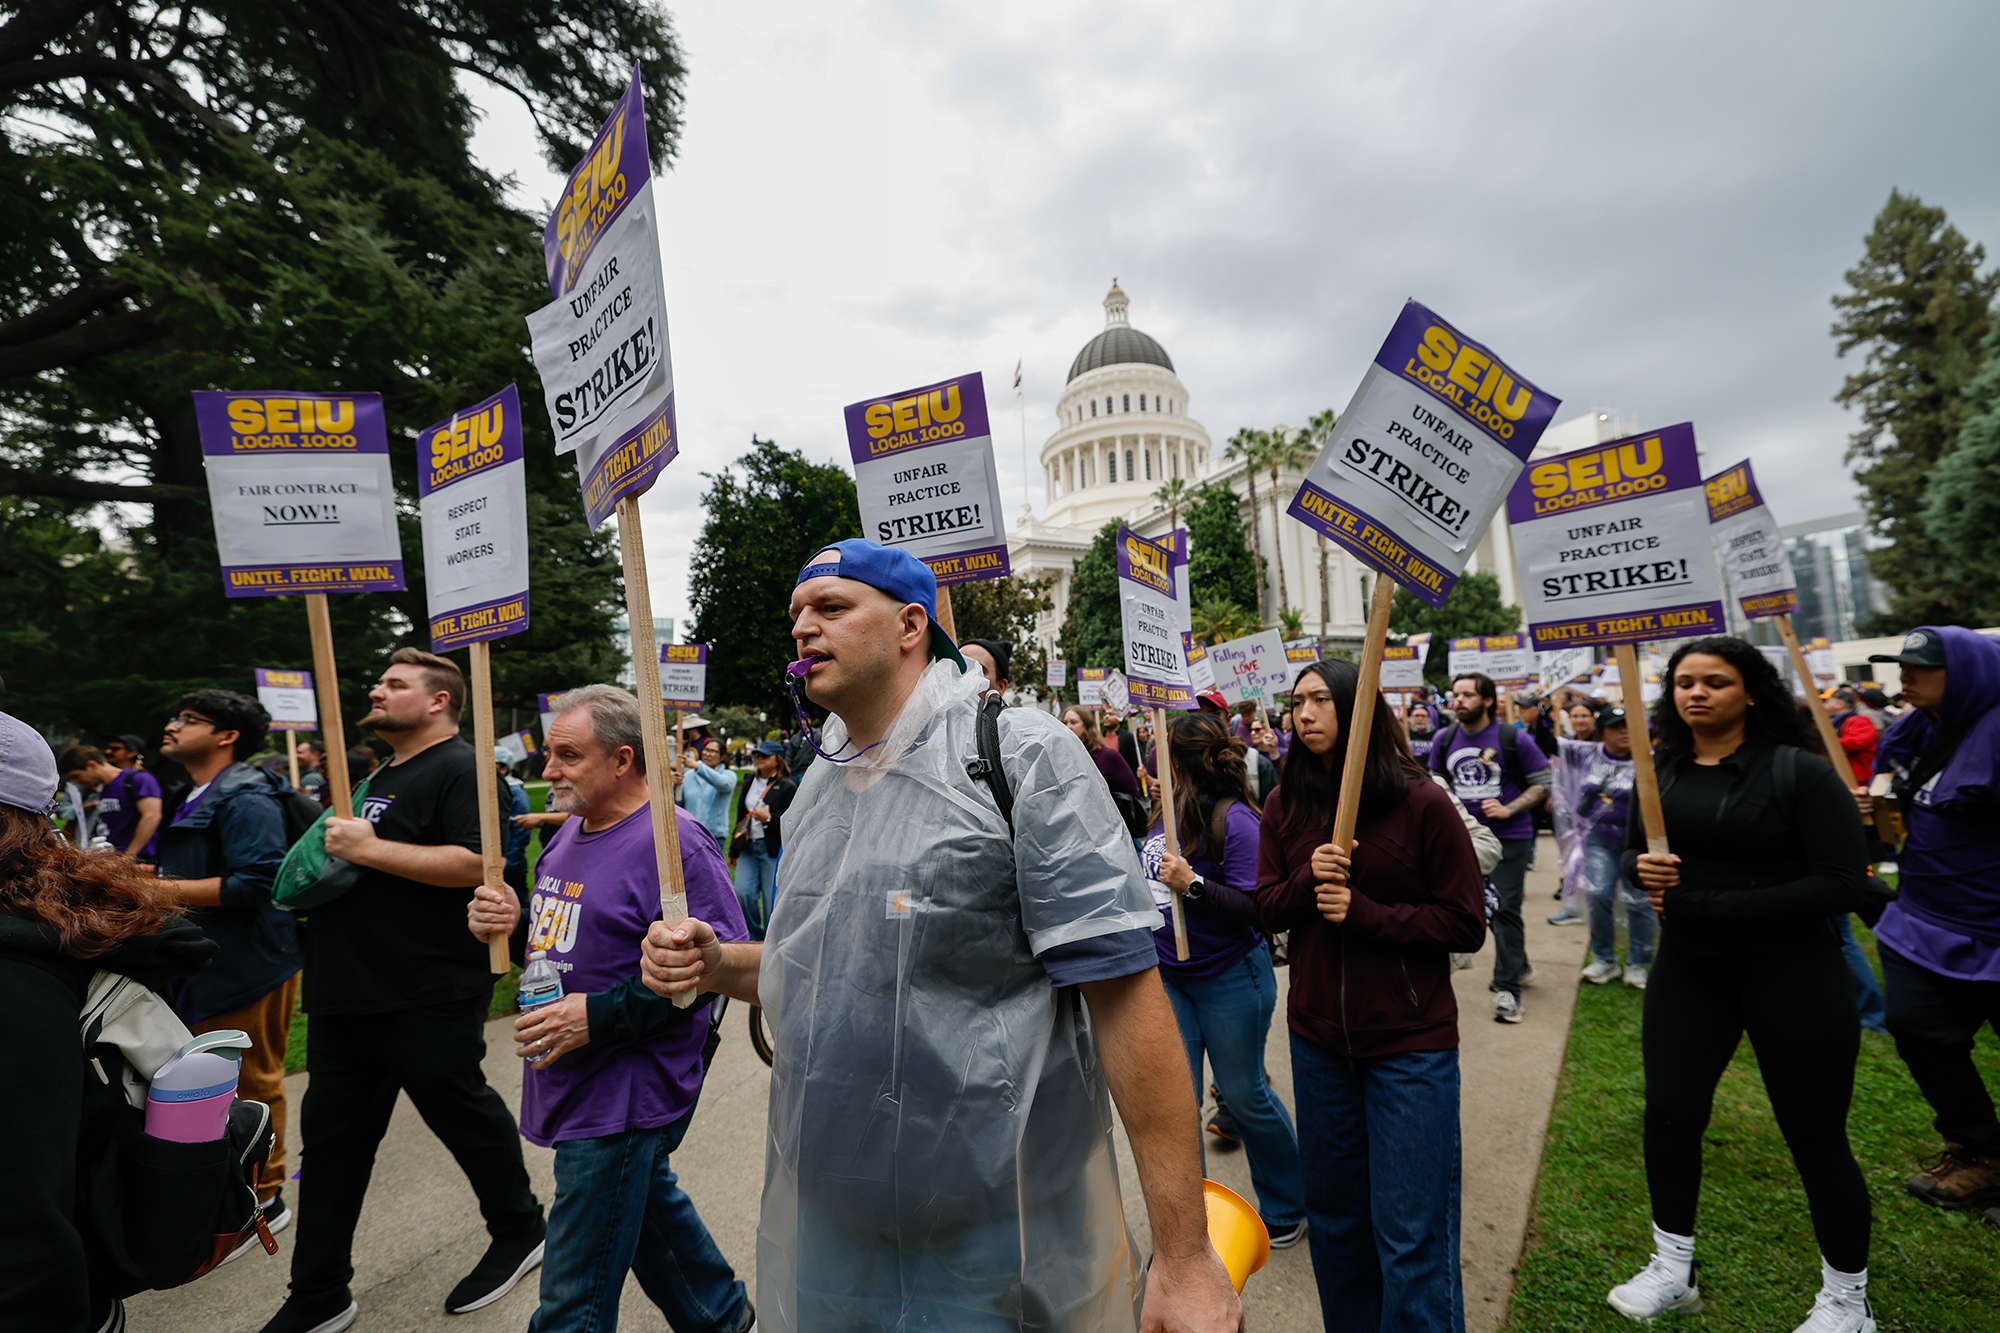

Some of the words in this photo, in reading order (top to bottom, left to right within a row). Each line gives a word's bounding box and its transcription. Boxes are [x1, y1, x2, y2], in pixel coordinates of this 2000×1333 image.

[557, 110, 625, 261] SEIU
[565, 232, 592, 287] LOCAL
[592, 172, 627, 236] 1000
[570, 256, 620, 318] UNFAIR
[568, 285, 632, 362] PRACTICE
[554, 317, 655, 431] STRIKE!
[1417, 325, 1533, 422] SEIU
[865, 385, 962, 439] SEIU
[1402, 357, 1467, 408] LOCAL
[1468, 397, 1516, 440] 1000
[227, 398, 355, 434] SEIU
[1412, 403, 1474, 456] UNFAIR
[231, 434, 298, 449] LOCAL
[300, 434, 358, 448] 1000
[431, 403, 504, 470] SEIU
[604, 441, 641, 487] FIGHT.
[641, 415, 671, 459] WIN.
[869, 432, 918, 454] LOCAL
[919, 421, 965, 441] 1000
[1386, 420, 1470, 485] PRACTICE
[430, 460, 468, 487] LOCAL
[468, 444, 504, 469] 1000
[894, 463, 948, 484] UNFAIR
[1529, 437, 1664, 499] SEIU
[238, 484, 272, 496] FAIR
[274, 483, 358, 495] CONTRACT
[888, 482, 961, 506] PRACTICE
[1345, 437, 1471, 532] STRIKE!
[1534, 489, 1603, 514] LOCAL
[1603, 474, 1667, 498] 1000
[1705, 467, 1748, 508] SEIU
[263, 504, 338, 522] NOW!!
[448, 497, 488, 521] RESPECT
[878, 504, 981, 542] STRIKE!
[455, 522, 481, 541] STATE
[1300, 490, 1358, 535] UNITE.
[1360, 522, 1405, 567] FIGHT.
[1404, 555, 1444, 594] WIN.
[1567, 517, 1643, 540] UNFAIR
[446, 543, 494, 566] WORKERS
[927, 559, 964, 576] IGHT.
[964, 553, 1003, 571] WIN.
[1126, 537, 1168, 580] SEIU
[1559, 536, 1661, 563] PRACTICE
[230, 570, 289, 586] UNITE.
[290, 568, 347, 583] FIGHT.
[349, 567, 395, 581] WIN.
[1129, 564, 1154, 586] LOCAL
[1153, 574, 1169, 592] 1000
[1542, 558, 1689, 597] STRIKE!
[431, 618, 459, 640] UNITE.
[460, 608, 497, 630] FIGHT.
[497, 601, 525, 623] WIN.
[1141, 602, 1166, 621] UNFAIR
[1535, 624, 1595, 641] UNITE.
[1597, 616, 1658, 635] FIGHT.
[1659, 609, 1715, 628] WIN.
[1138, 620, 1168, 640] PRACTICE
[667, 646, 699, 658] SEIU
[1131, 641, 1178, 670] STRIKE!
[1213, 647, 1246, 664] Falling
[1251, 644, 1265, 655] in
[1233, 659, 1260, 675] LOVE
[662, 684, 699, 693] STRIKE!
[1130, 681, 1151, 696] UNITE.
[1167, 690, 1192, 701] WIN.
[1240, 685, 1265, 700] Bills
[1271, 671, 1286, 684] my
[538, 875, 561, 894] LOCAL
[563, 881, 584, 898] 1000
[528, 893, 582, 953] SEIU
